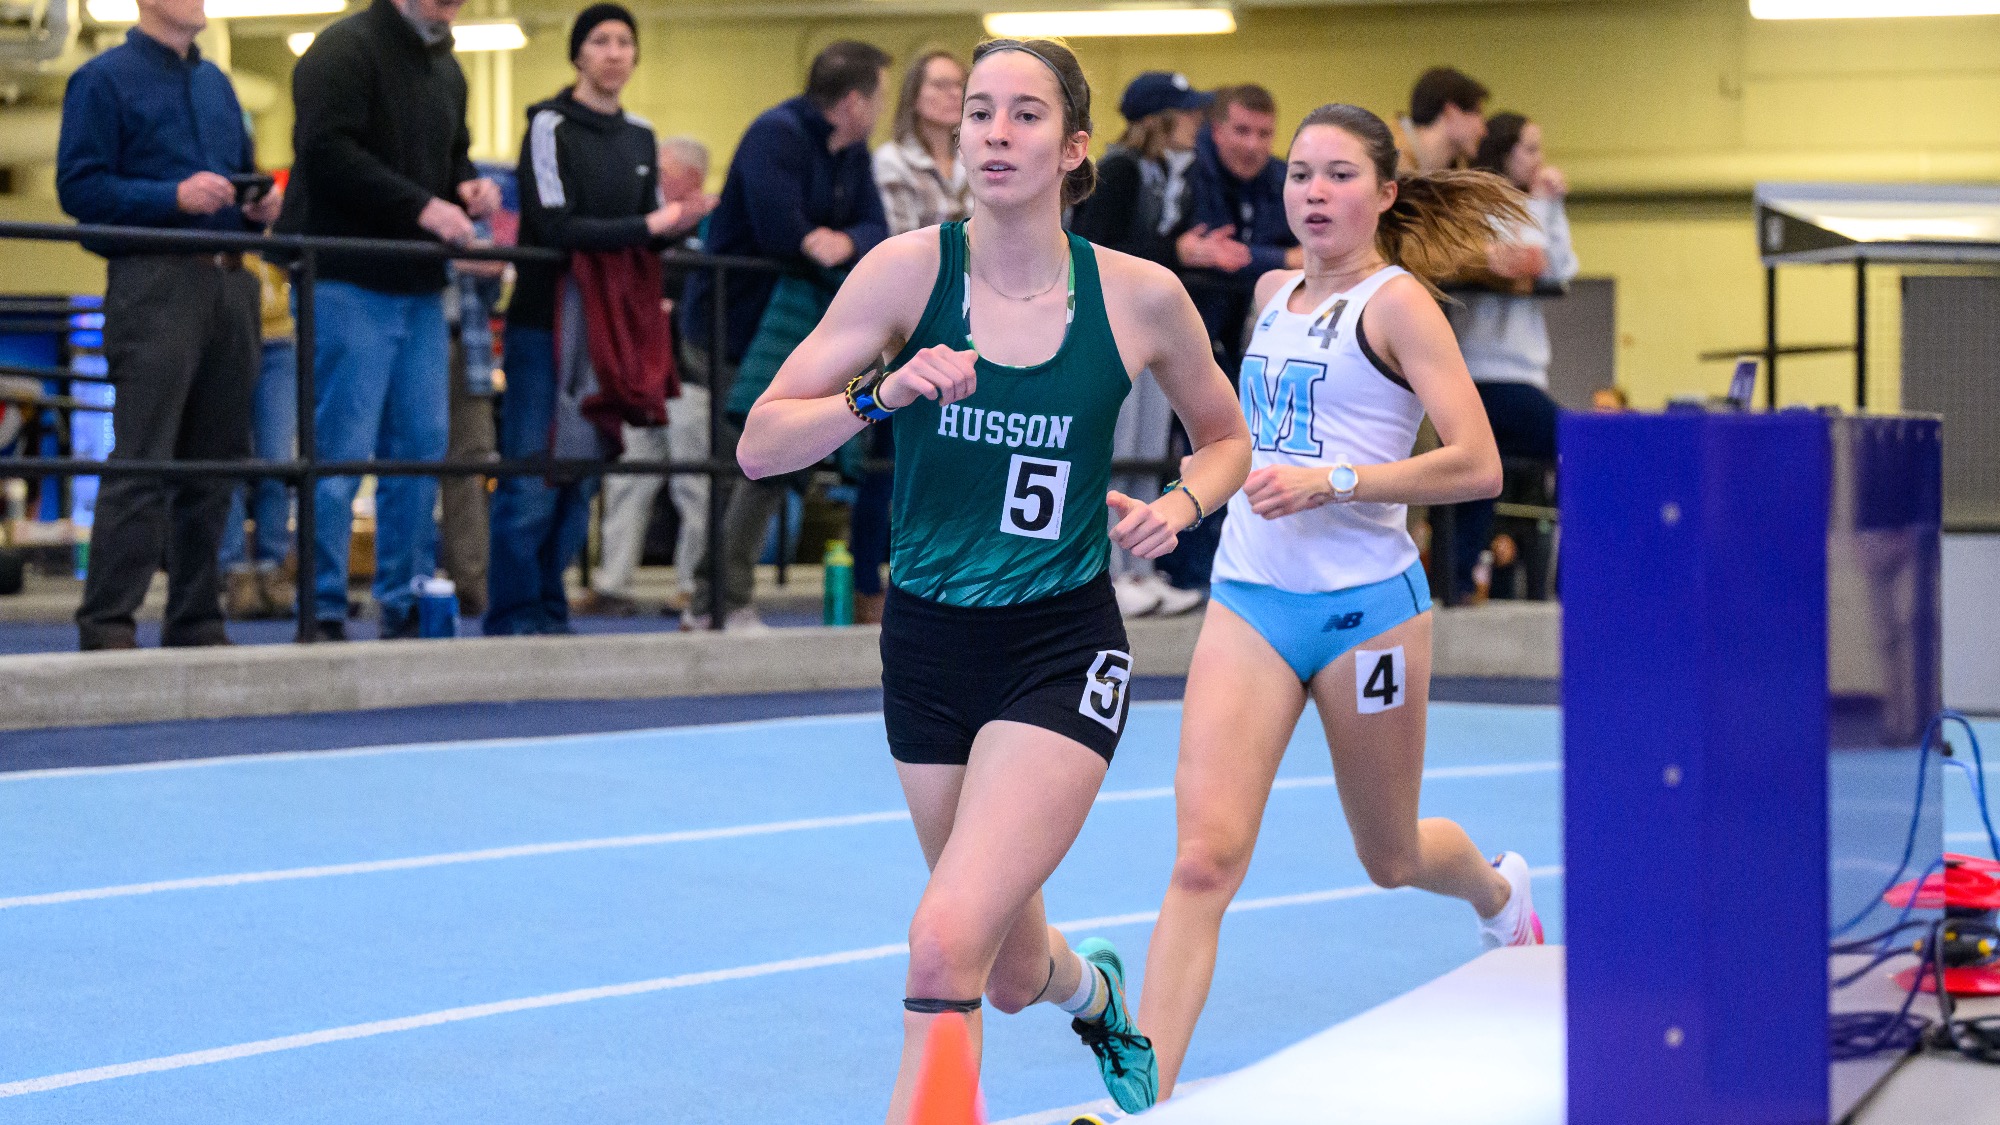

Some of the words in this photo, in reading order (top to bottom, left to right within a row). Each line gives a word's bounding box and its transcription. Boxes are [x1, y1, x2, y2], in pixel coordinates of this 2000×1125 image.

[1308, 299, 1349, 349] 4
[938, 403, 1073, 449] HUSSON
[1239, 355, 1328, 458] M
[1010, 461, 1058, 532] 5
[1090, 652, 1129, 720] 5
[1363, 653, 1399, 706] 4
